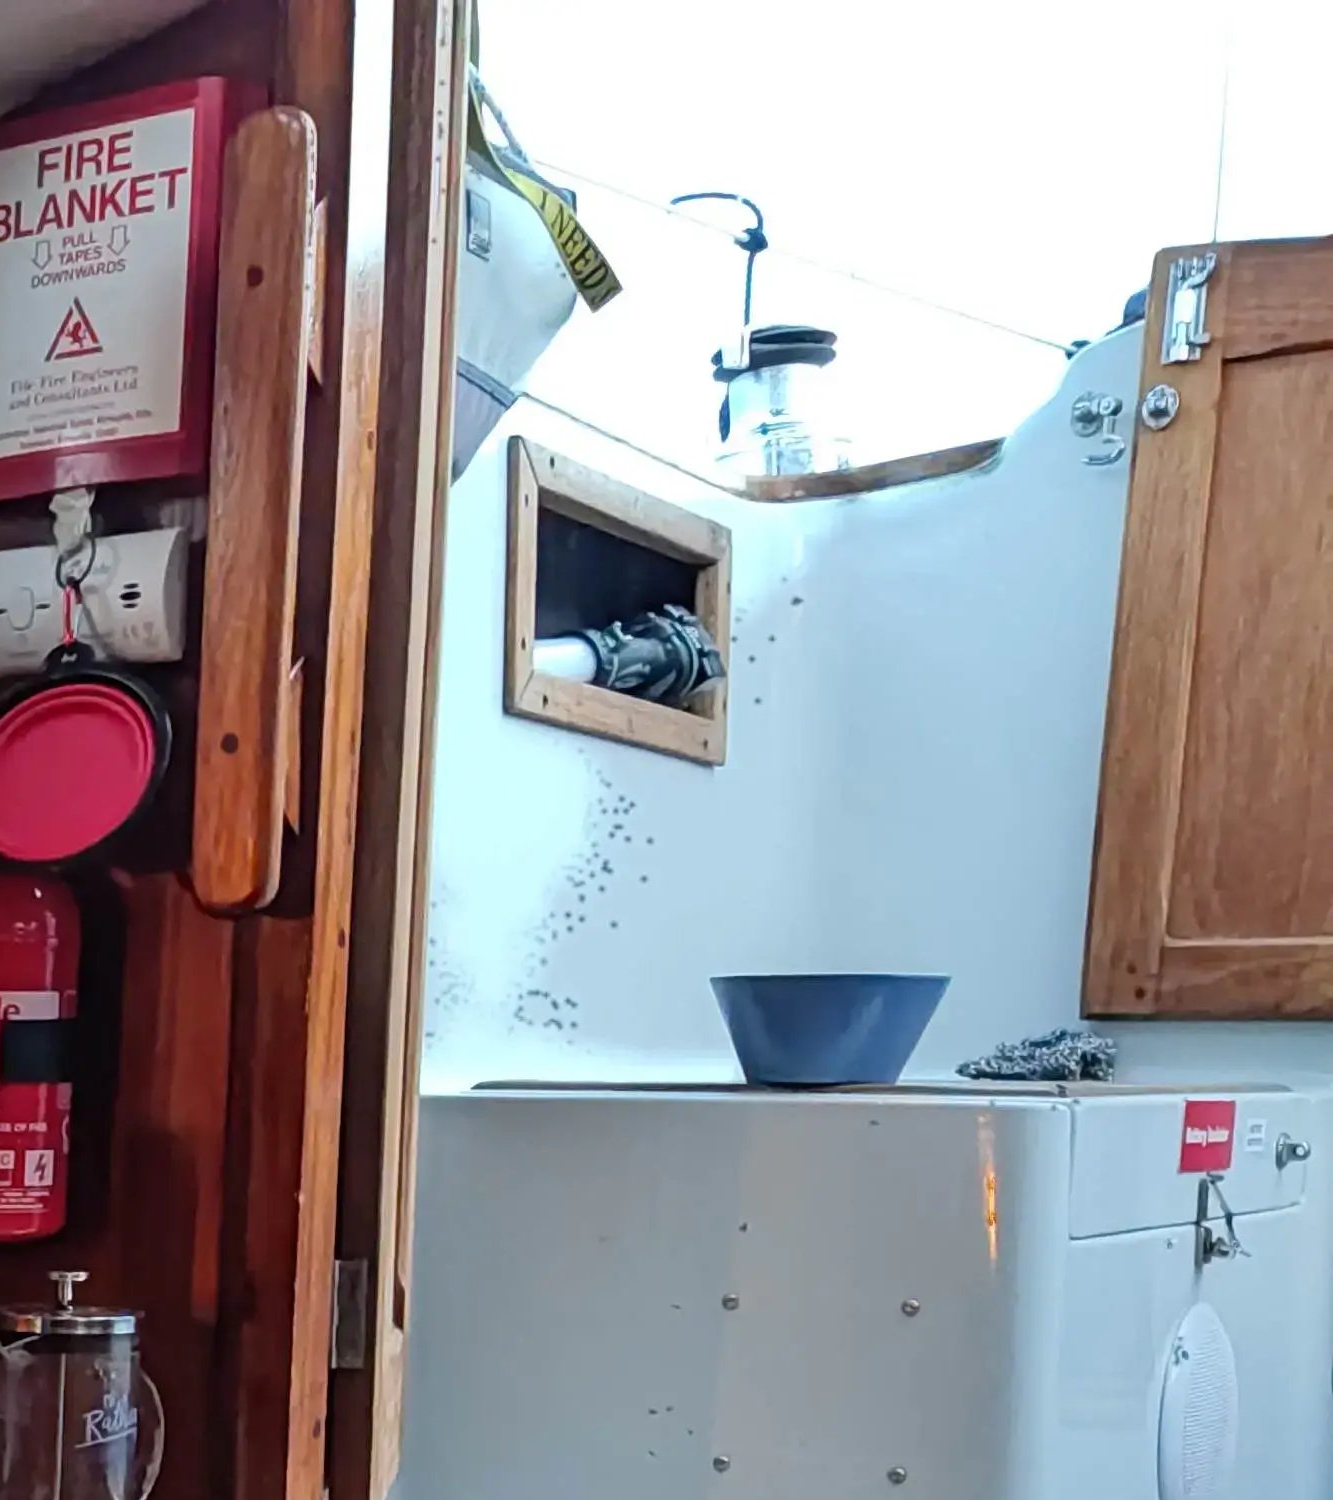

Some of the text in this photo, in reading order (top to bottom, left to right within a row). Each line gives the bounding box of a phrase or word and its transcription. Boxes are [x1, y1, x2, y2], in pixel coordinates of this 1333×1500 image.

[37, 130, 133, 188] FIRE
[62, 228, 97, 250] PULL
[59, 245, 103, 266] TAPES
[31, 258, 127, 290] DOWNWARDS
